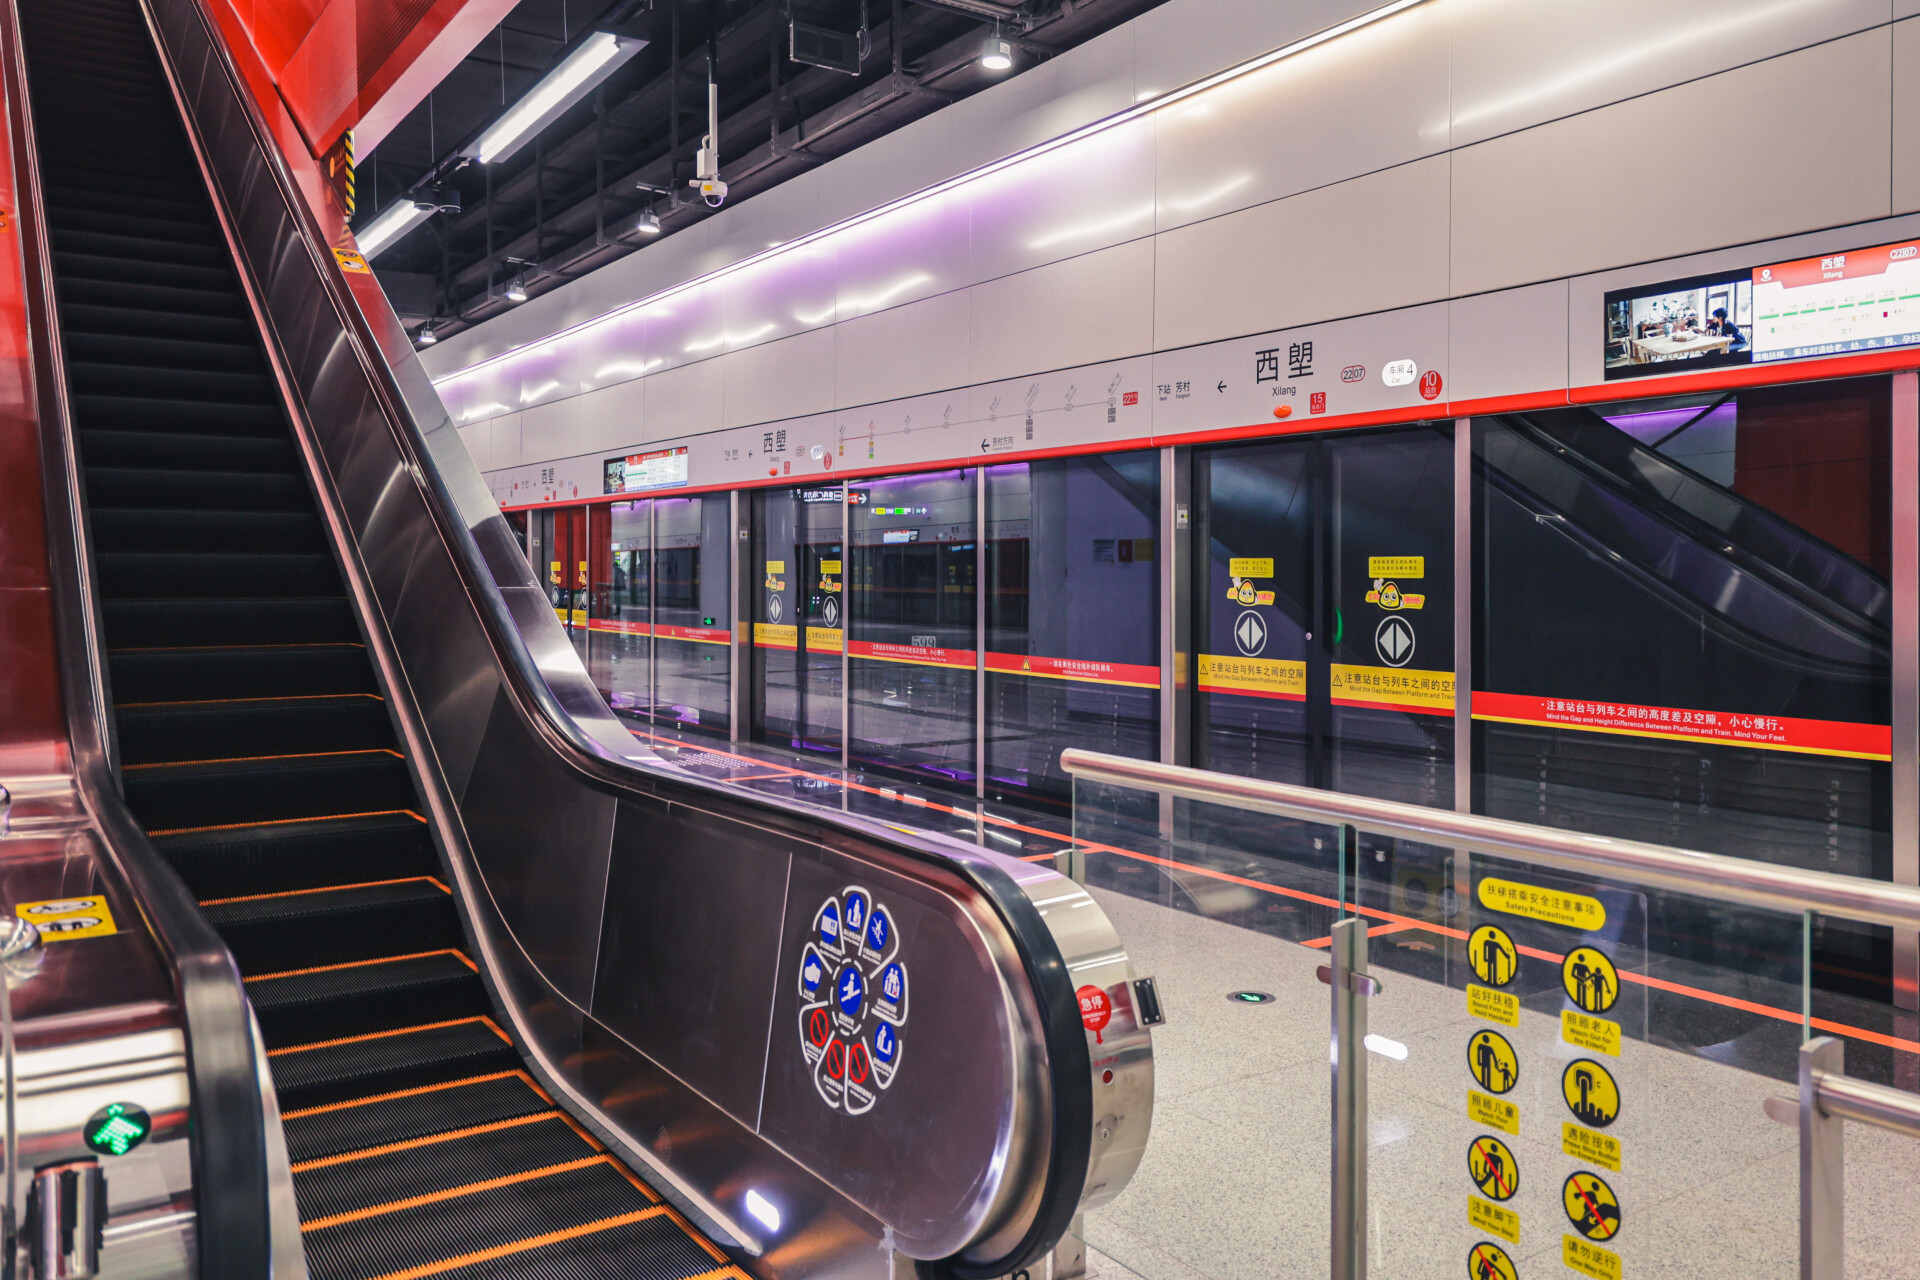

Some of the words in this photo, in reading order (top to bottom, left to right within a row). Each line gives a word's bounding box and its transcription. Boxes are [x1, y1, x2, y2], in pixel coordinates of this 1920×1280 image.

[1821, 255, 1846, 271] 西塱
[1822, 271, 1844, 279] Xilang
[1255, 341, 1314, 384] 西塱
[1406, 363, 1414, 375] 4
[1156, 384, 1171, 395] 下站
[1175, 380, 1190, 393] 芳村
[1423, 372, 1437, 386] 10
[1272, 386, 1297, 397] Xilang
[1312, 393, 1323, 404] 15
[1210, 662, 1304, 679] 注意站台与列车之间的空隙
[1371, 687, 1382, 695] Gap
[1383, 688, 1406, 696] Between
[1406, 690, 1428, 698] Platform
[1570, 715, 1582, 723] Gap
[1594, 717, 1613, 726] Height
[1614, 719, 1644, 728] Difference
[1645, 722, 1672, 731] Between
[1673, 725, 1699, 734] Platform
[1714, 729, 1732, 737] Train.
[1734, 730, 1750, 738] Mind
[1751, 732, 1767, 740] Your
[1768, 734, 1787, 742] Feet.
[1487, 885, 1596, 916] 扶梯搭乘安全注意事项
[1505, 901, 1529, 913] Safety
[1530, 906, 1575, 922] Precautions
[1080, 995, 1103, 1012] 急停
[1471, 987, 1514, 1009] 站好扶稳
[1472, 1000, 1488, 1008] Stand
[1489, 1004, 1500, 1013] Firm
[1502, 1009, 1513, 1017] and
[1474, 1008, 1486, 1016] Hold
[1486, 1012, 1511, 1023] Handrail
[1566, 1013, 1615, 1037] 照顾老人
[1570, 1027, 1588, 1037] Watch
[1589, 1032, 1601, 1041] Out
[1602, 1036, 1611, 1044] for
[1574, 1036, 1584, 1044] the
[1585, 1039, 1607, 1051] Elderly
[1472, 1094, 1514, 1119] 照顾儿童
[1478, 1108, 1494, 1119] Watch
[1495, 1114, 1508, 1125] Your
[1481, 1118, 1505, 1131] Children
[1567, 1127, 1616, 1154] 遇险按停
[1563, 1138, 1581, 1150] Press
[1582, 1145, 1597, 1157] Stop
[1598, 1150, 1620, 1163] Button
[1577, 1151, 1613, 1170] Emergency
[1472, 1200, 1514, 1226] 注意脚下
[1472, 1216, 1487, 1226] Mind
[1488, 1222, 1500, 1232] Your
[1501, 1228, 1514, 1239] Step
[1568, 1240, 1617, 1270] 请勿逆行
[1570, 1256, 1582, 1266] One
[1583, 1262, 1597, 1274] Way
[1598, 1268, 1614, 1280] Only
